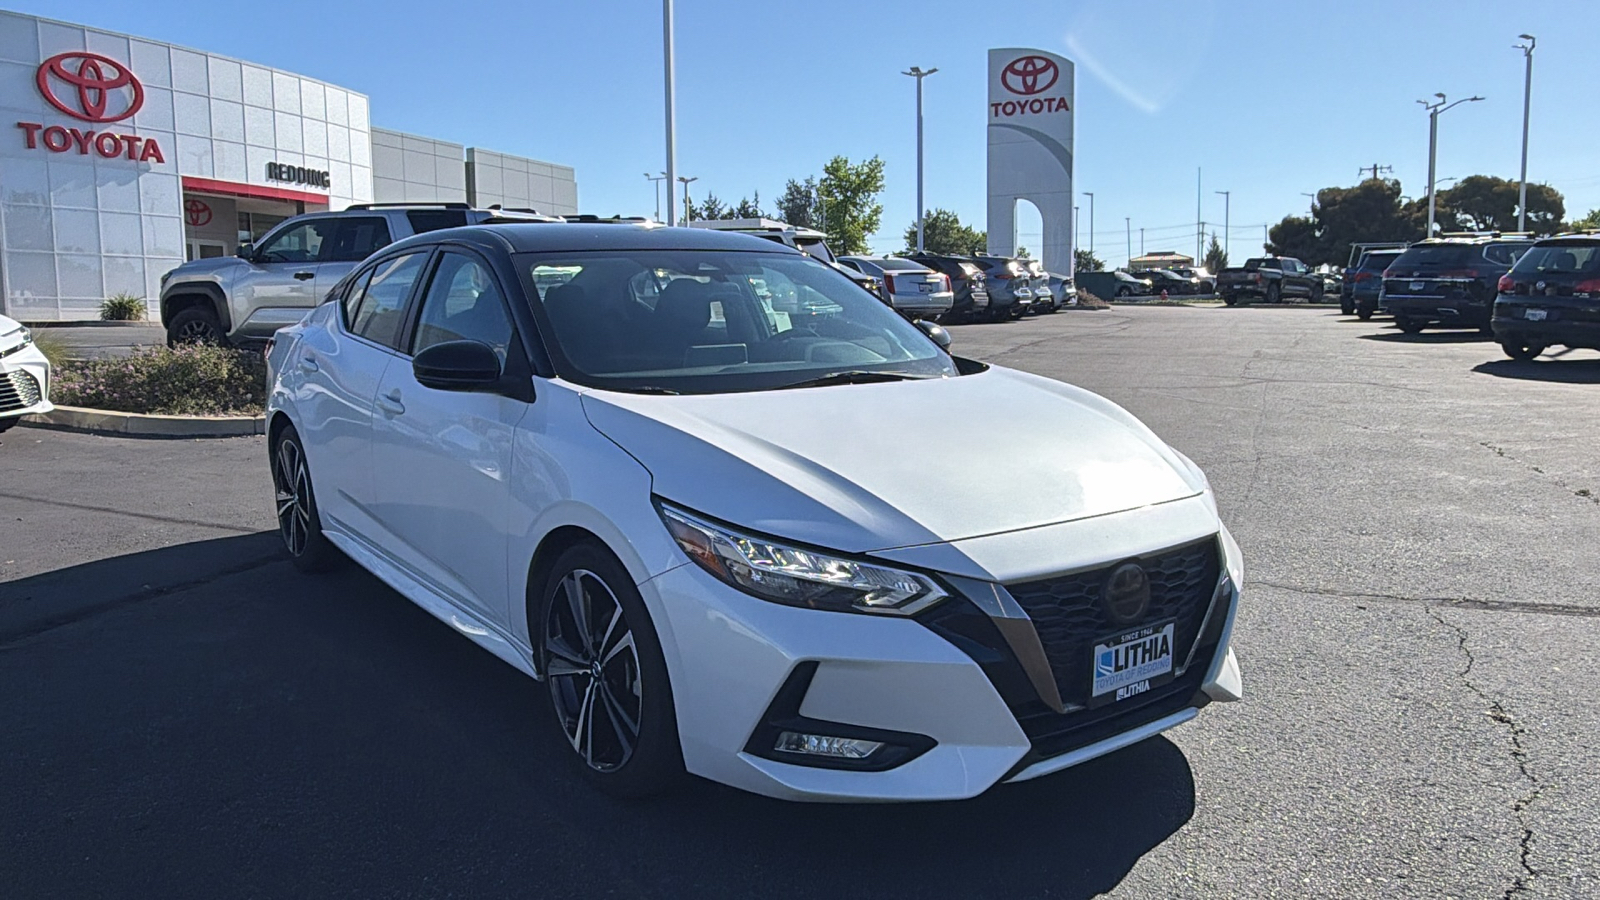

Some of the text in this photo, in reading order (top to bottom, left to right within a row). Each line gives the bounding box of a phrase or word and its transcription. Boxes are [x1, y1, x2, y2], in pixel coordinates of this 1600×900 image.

[991, 97, 1069, 117] TOYOTA
[17, 122, 165, 164] TOYOTA
[266, 162, 331, 188] REDDING
[1121, 631, 1140, 643] SINCE
[1114, 634, 1170, 673] LITHIA
[1095, 656, 1170, 689] TOYOTA OF REDDING
[1124, 680, 1150, 698] LITHIA
